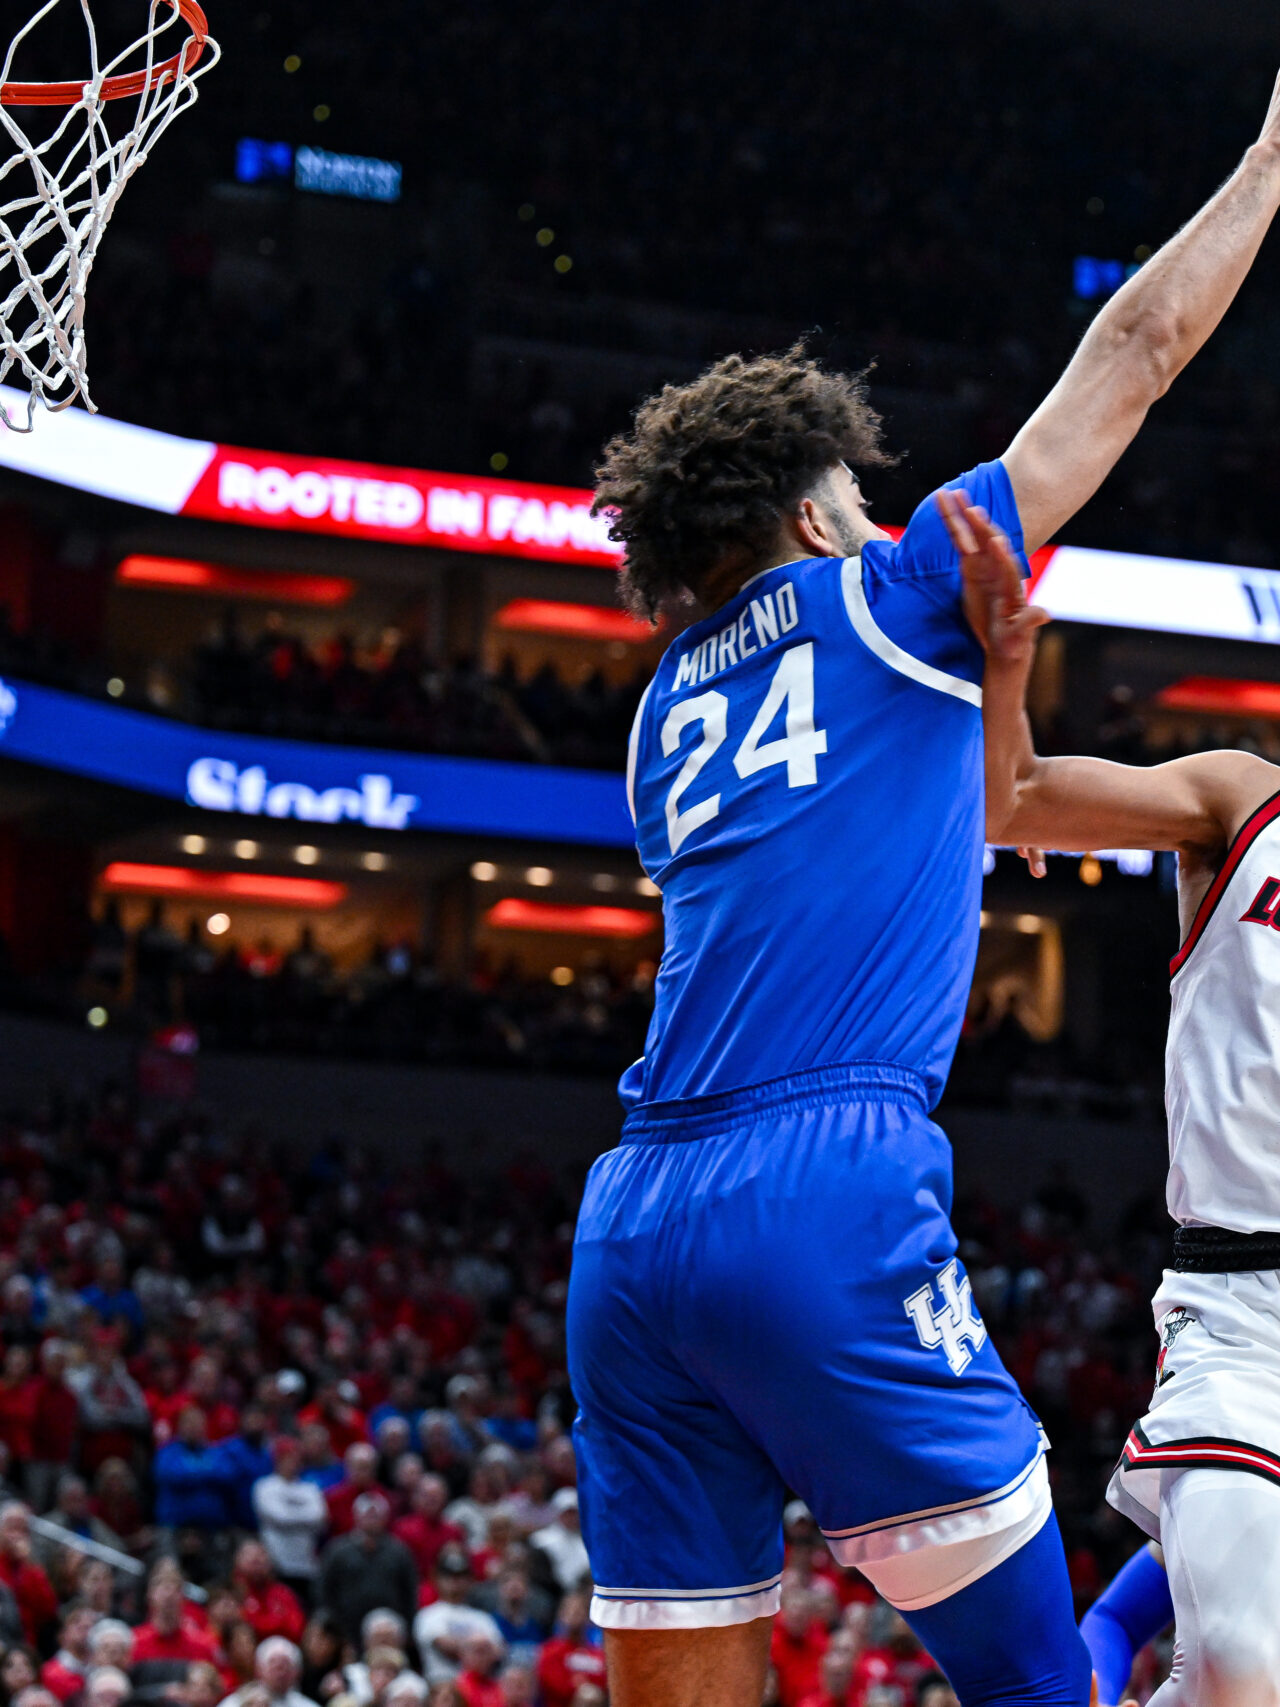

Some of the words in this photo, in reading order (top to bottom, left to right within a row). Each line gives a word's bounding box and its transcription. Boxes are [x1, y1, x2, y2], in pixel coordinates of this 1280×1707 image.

[218, 460, 424, 528] ROOTED
[426, 487, 484, 537] IN
[671, 581, 799, 692] MORENO
[187, 757, 421, 830] Stock
[660, 641, 828, 857] 24
[903, 1257, 988, 1377] UK
